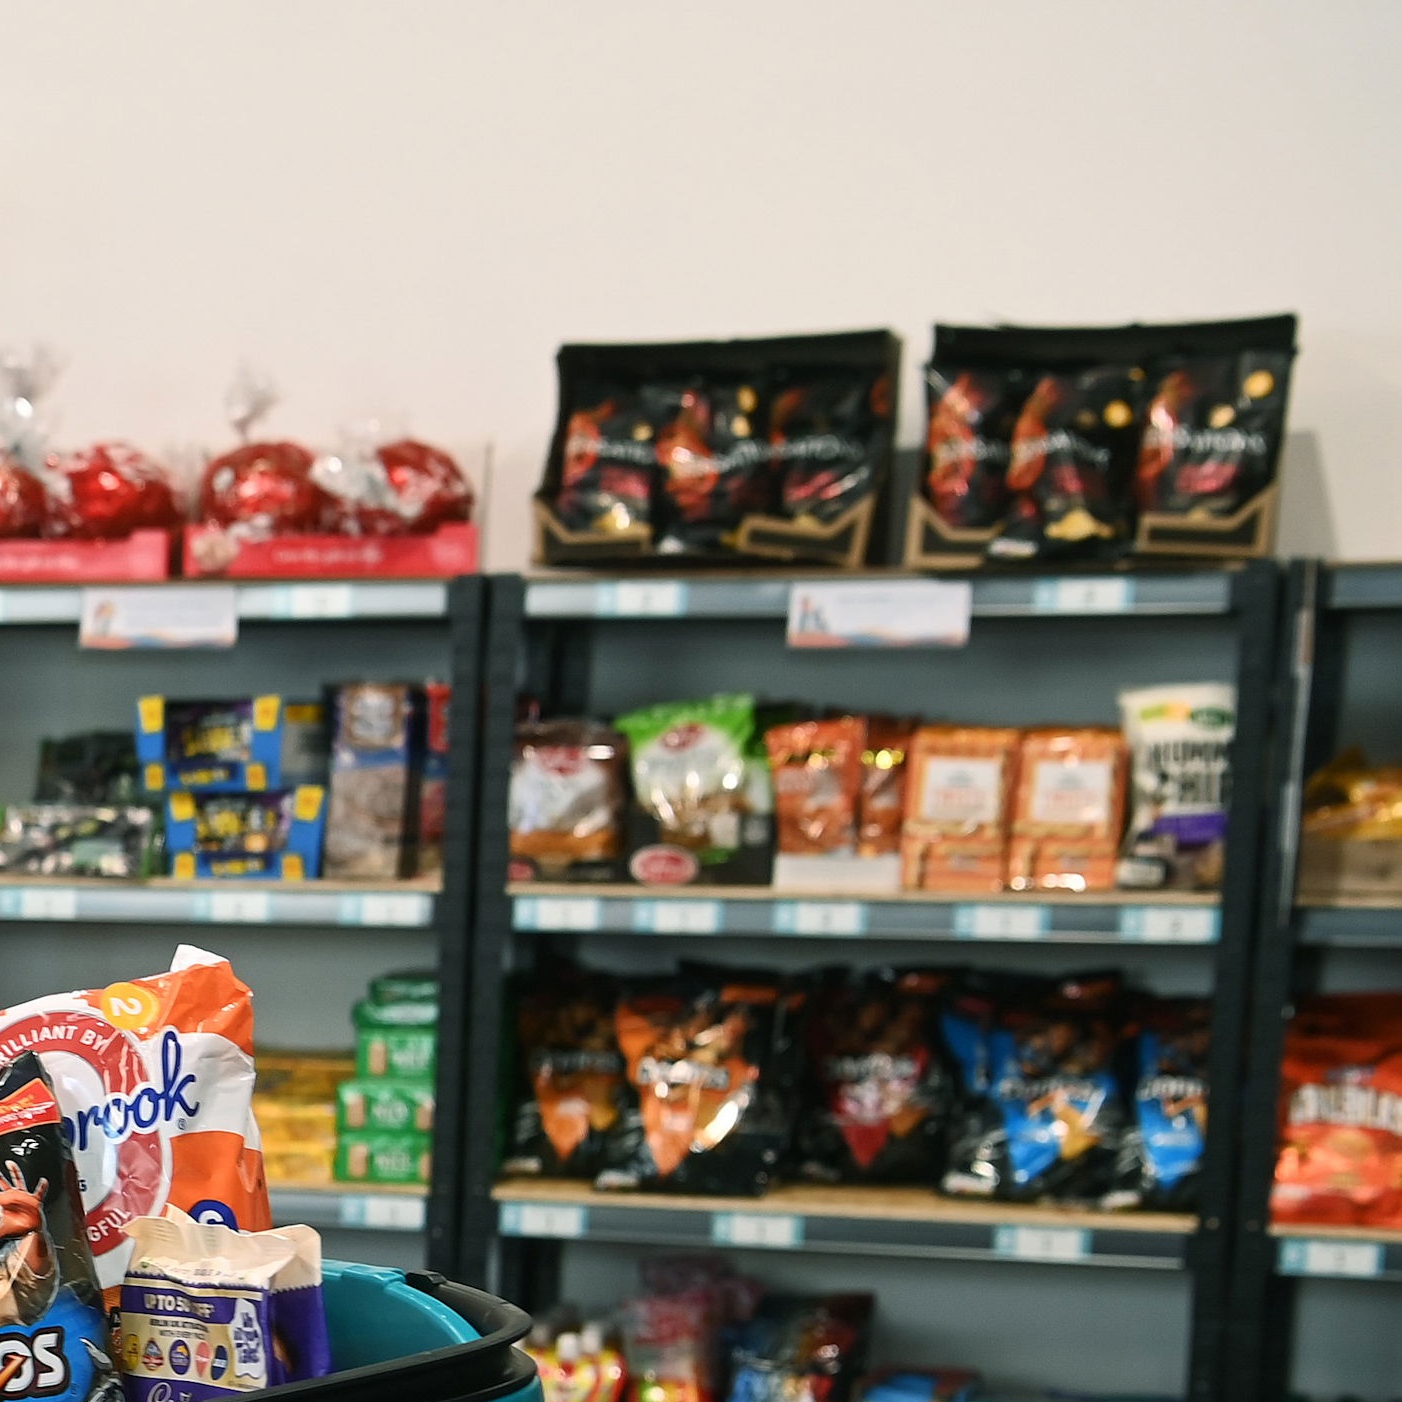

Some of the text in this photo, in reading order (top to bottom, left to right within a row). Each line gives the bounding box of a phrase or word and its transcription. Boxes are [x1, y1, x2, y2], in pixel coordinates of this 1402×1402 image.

[110, 997, 144, 1017] 2
[79, 1030, 108, 1053] BY
[157, 1294, 176, 1311] TO
